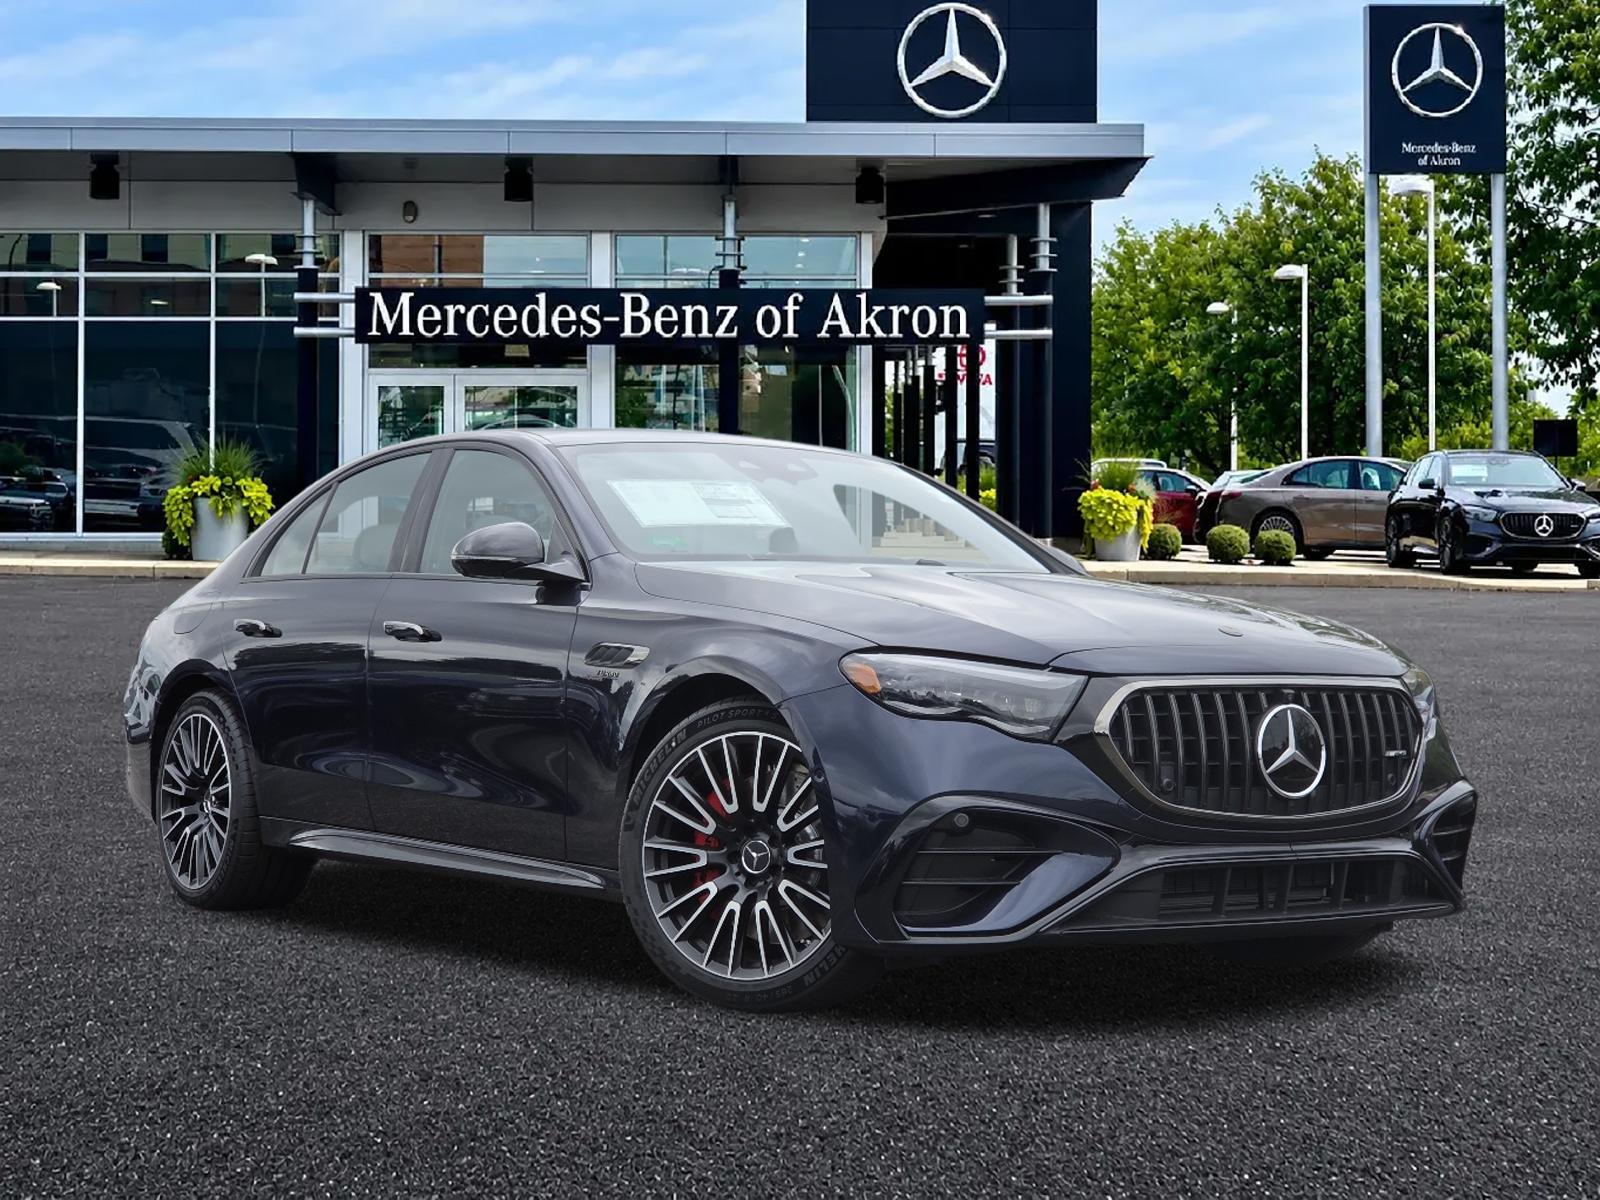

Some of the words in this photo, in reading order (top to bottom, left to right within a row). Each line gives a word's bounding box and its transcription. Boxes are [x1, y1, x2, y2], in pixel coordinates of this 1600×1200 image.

[1401, 142, 1477, 153] Mercedes-Benz
[1418, 155, 1428, 166] of
[1430, 154, 1461, 166] Akron
[367, 292, 738, 338] Mercedes-Benz
[755, 292, 803, 339] of
[816, 292, 971, 339] Akron
[696, 711, 725, 728] PILOT
[727, 708, 764, 719] SPORT
[631, 728, 688, 806] MICHELIN
[803, 945, 848, 987] HELIN
